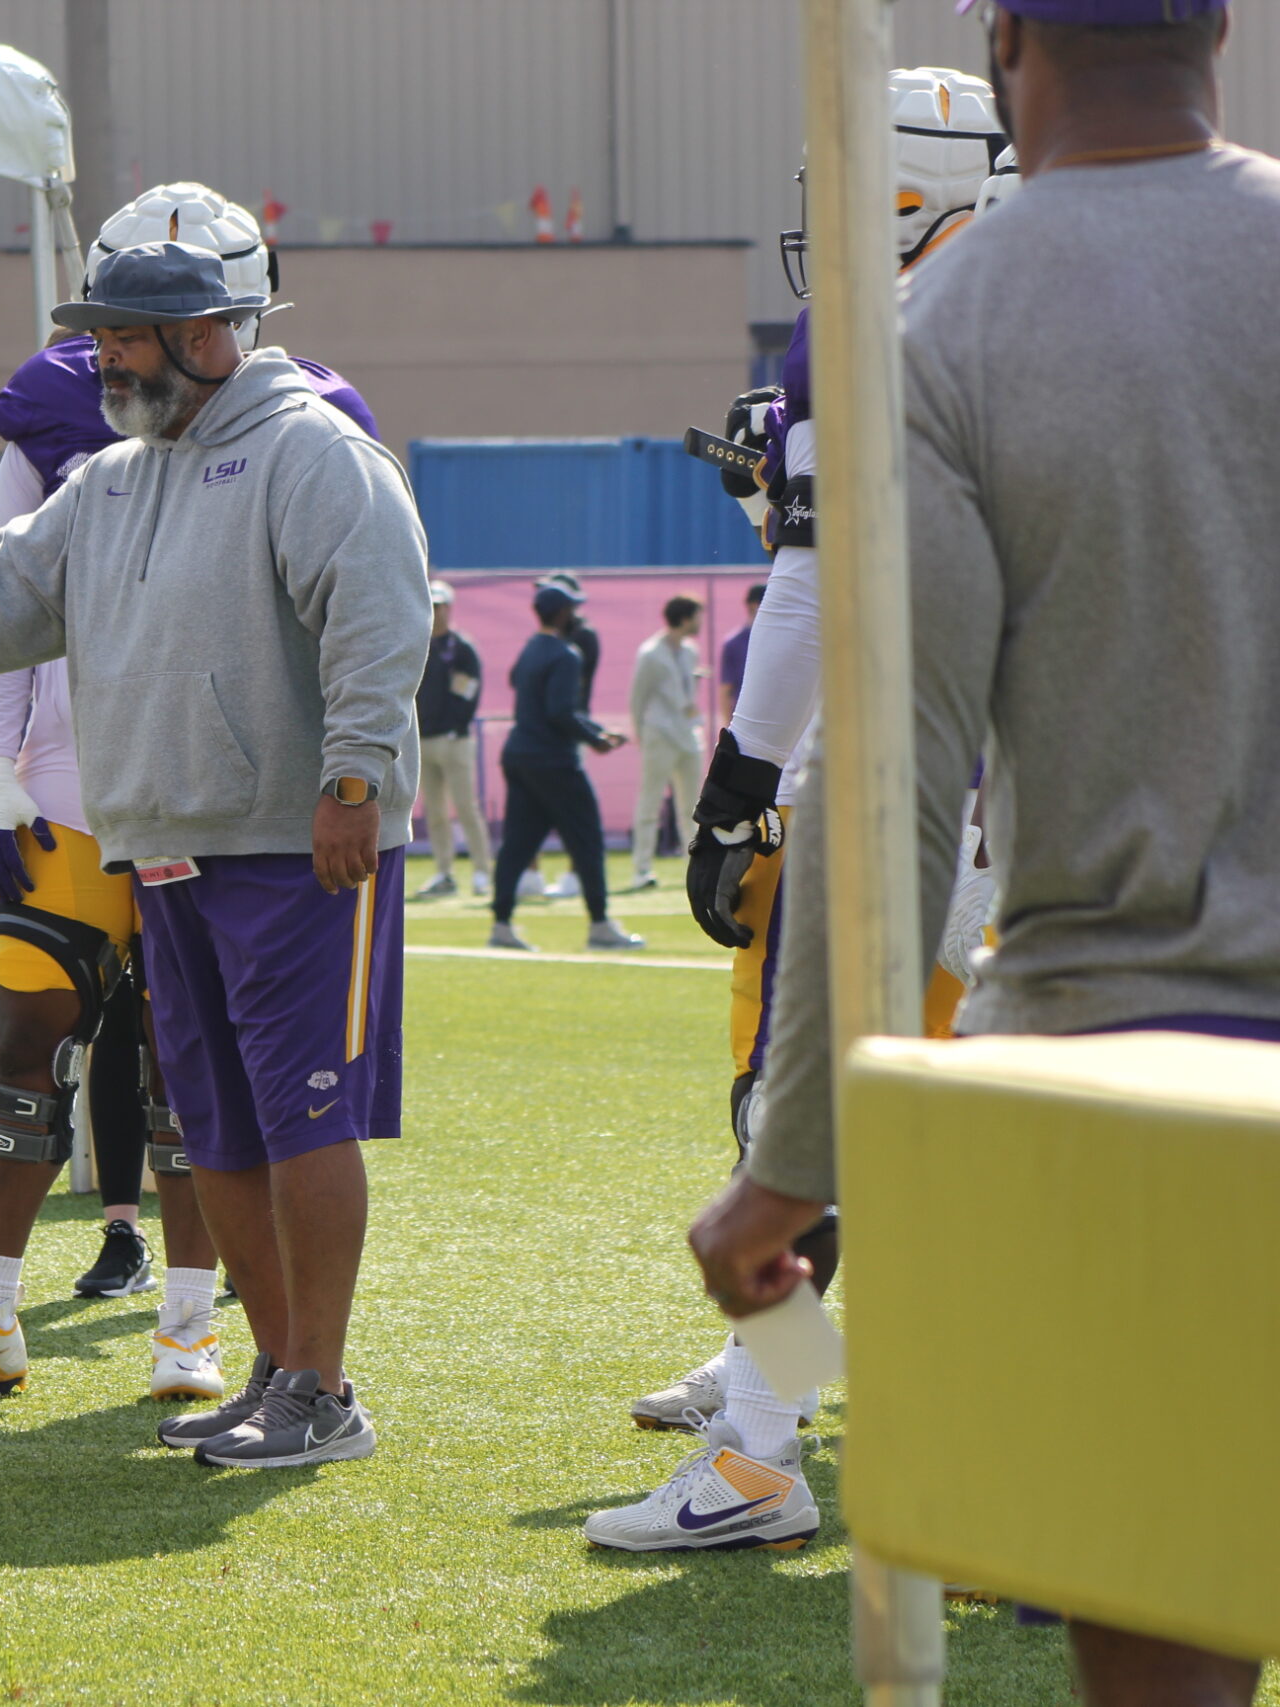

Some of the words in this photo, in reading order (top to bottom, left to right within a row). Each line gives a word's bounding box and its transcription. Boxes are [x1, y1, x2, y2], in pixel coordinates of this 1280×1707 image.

[202, 457, 248, 483] LSU
[765, 807, 782, 847] NIKE
[729, 1510, 783, 1532] FORCE
